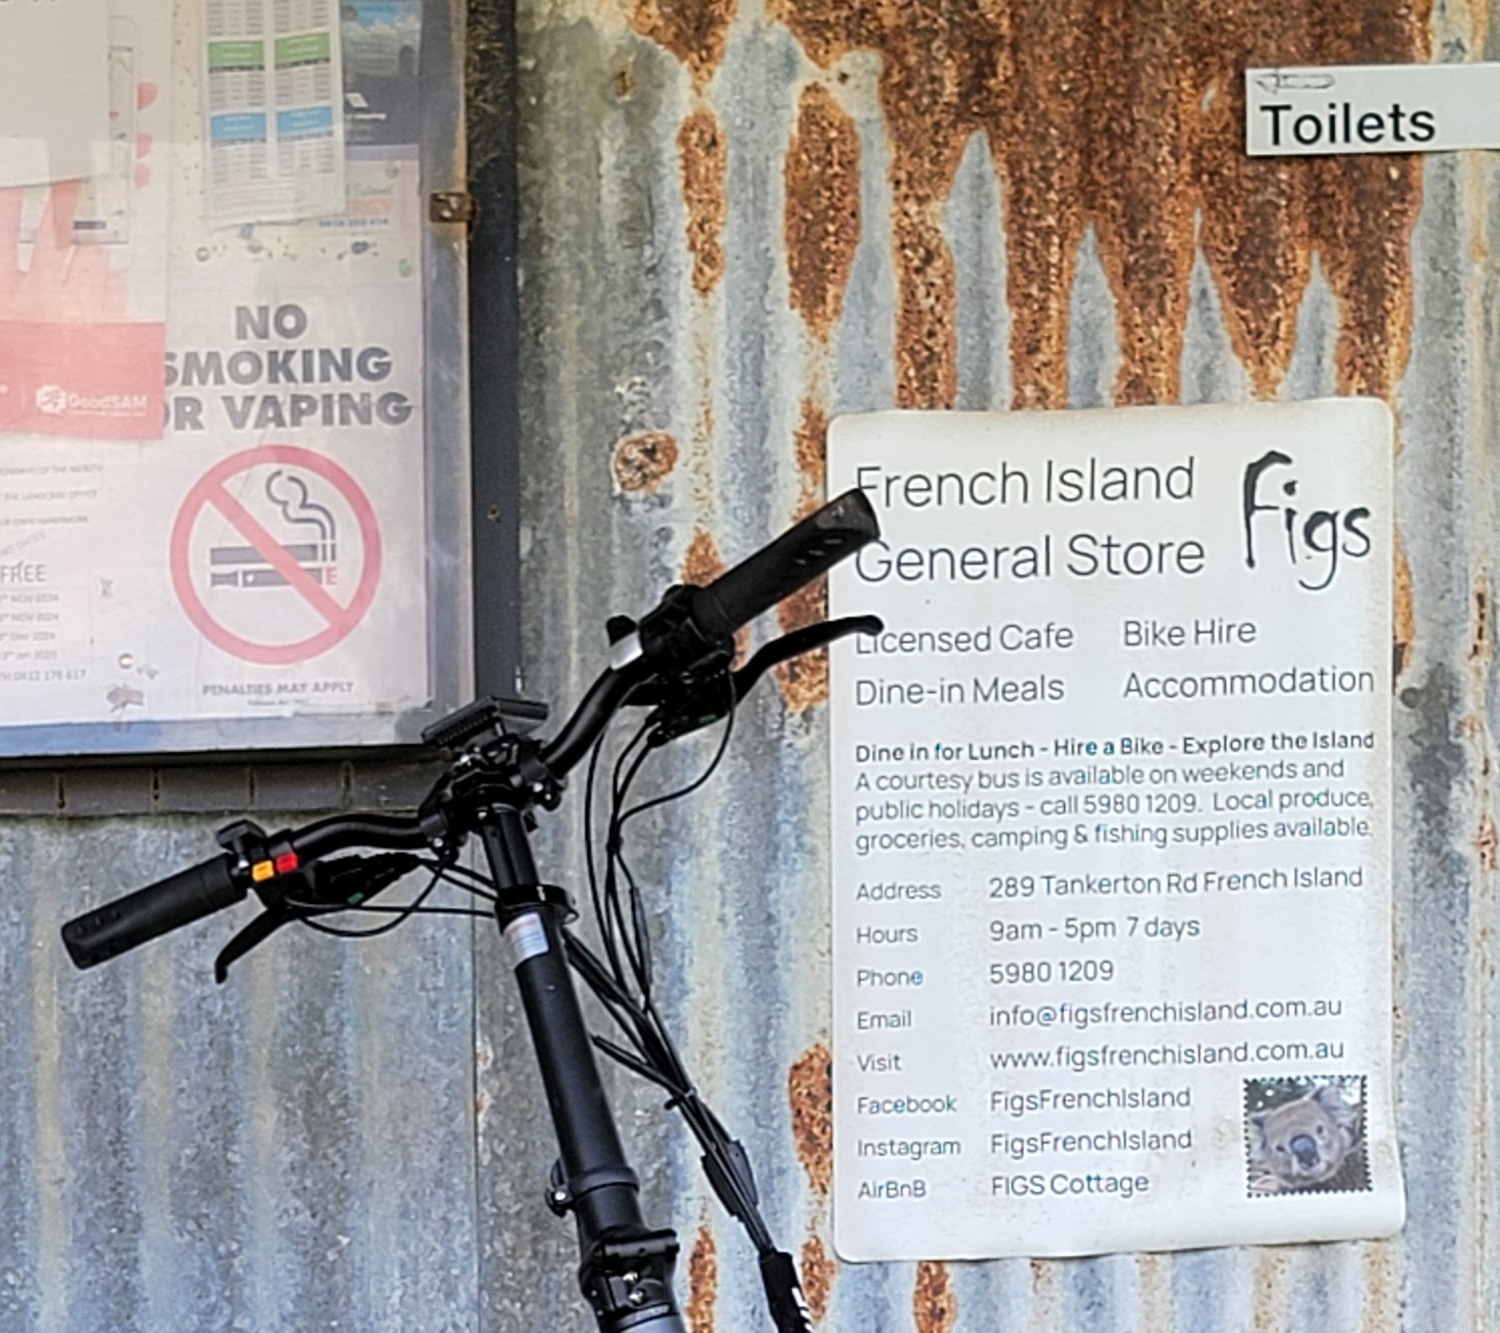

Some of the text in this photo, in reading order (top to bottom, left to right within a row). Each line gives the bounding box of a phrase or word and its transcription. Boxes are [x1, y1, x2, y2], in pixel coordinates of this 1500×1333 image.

[1260, 102, 1436, 146] Toilets
[235, 303, 308, 340] NO
[68, 394, 148, 409] GoodSAM
[162, 391, 412, 431] R VAPING
[856, 457, 1196, 508] French Island
[0, 563, 46, 583] FREE
[855, 532, 1206, 582] General Store
[856, 621, 1075, 655] Licensed Cafe
[1123, 618, 1257, 648] Bike Hire
[202, 681, 354, 696] PENALTIES MAY APPLY
[856, 673, 1066, 707] Dine-in Meals
[1122, 667, 1375, 699] Accommodation
[856, 744, 905, 763] Dine
[910, 743, 929, 762] in
[934, 741, 963, 761] for
[968, 739, 1035, 762] Lunch
[1053, 738, 1098, 758] Hire
[1103, 742, 1115, 756] a
[1120, 737, 1164, 757] Bike
[1183, 734, 1265, 759] Explore
[1271, 732, 1308, 751] the
[1312, 731, 1375, 751] Island
[855, 759, 1345, 794] A courtesy bus is available on weekends and
[856, 800, 925, 824] public
[928, 798, 1020, 823] holidays
[1040, 796, 1079, 816] call
[1083, 795, 1141, 815] 5980
[1212, 791, 1273, 813] Local
[971, 825, 1068, 852] camping
[1073, 825, 1089, 845] &
[1094, 821, 1168, 849] fishing
[1172, 818, 1269, 846] supplies
[856, 880, 942, 902] Address
[989, 867, 1363, 900] 289 Tankerton Rd French Island
[856, 926, 919, 945] Hours
[989, 920, 1043, 943] 9am
[1064, 918, 1117, 945] 5pm
[1126, 916, 1139, 939] 7
[1143, 915, 1201, 943] days
[857, 967, 924, 988] Phone
[989, 960, 1114, 986] 5980 1209
[857, 1010, 912, 1030] Email
[989, 995, 1343, 1030] info@figsfrenchisland.com.au
[857, 1053, 902, 1073] Visit
[990, 1039, 1345, 1073] www.figsfrenchisland.com.au
[857, 1094, 957, 1116] Facebook
[990, 1085, 1192, 1118] FigsFrenchIsland
[857, 1137, 962, 1161] Instagram
[990, 1129, 1193, 1161] FigsFrenchIsland
[857, 1178, 927, 1200] AirBnB
[991, 1171, 1150, 1199] FIGS Cottage
